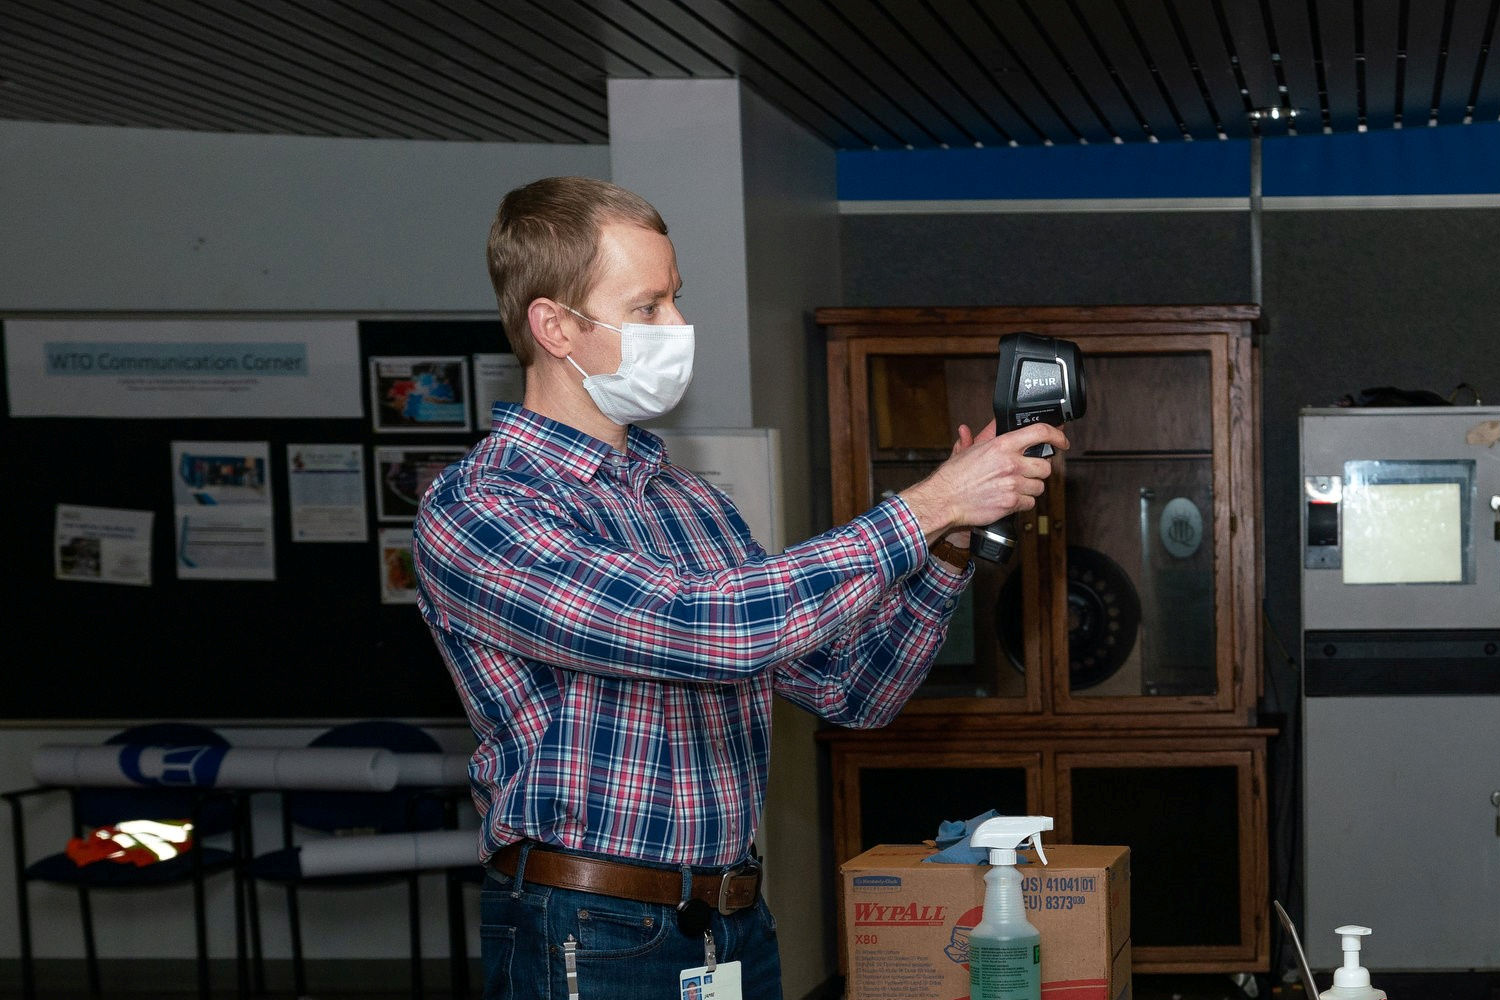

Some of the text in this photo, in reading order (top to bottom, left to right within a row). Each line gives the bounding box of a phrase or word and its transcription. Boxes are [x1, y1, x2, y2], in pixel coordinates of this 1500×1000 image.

[97, 352, 239, 371] Communication
[242, 352, 303, 371] Corner
[1032, 377, 1056, 387] FLIR
[855, 935, 878, 945] X80
